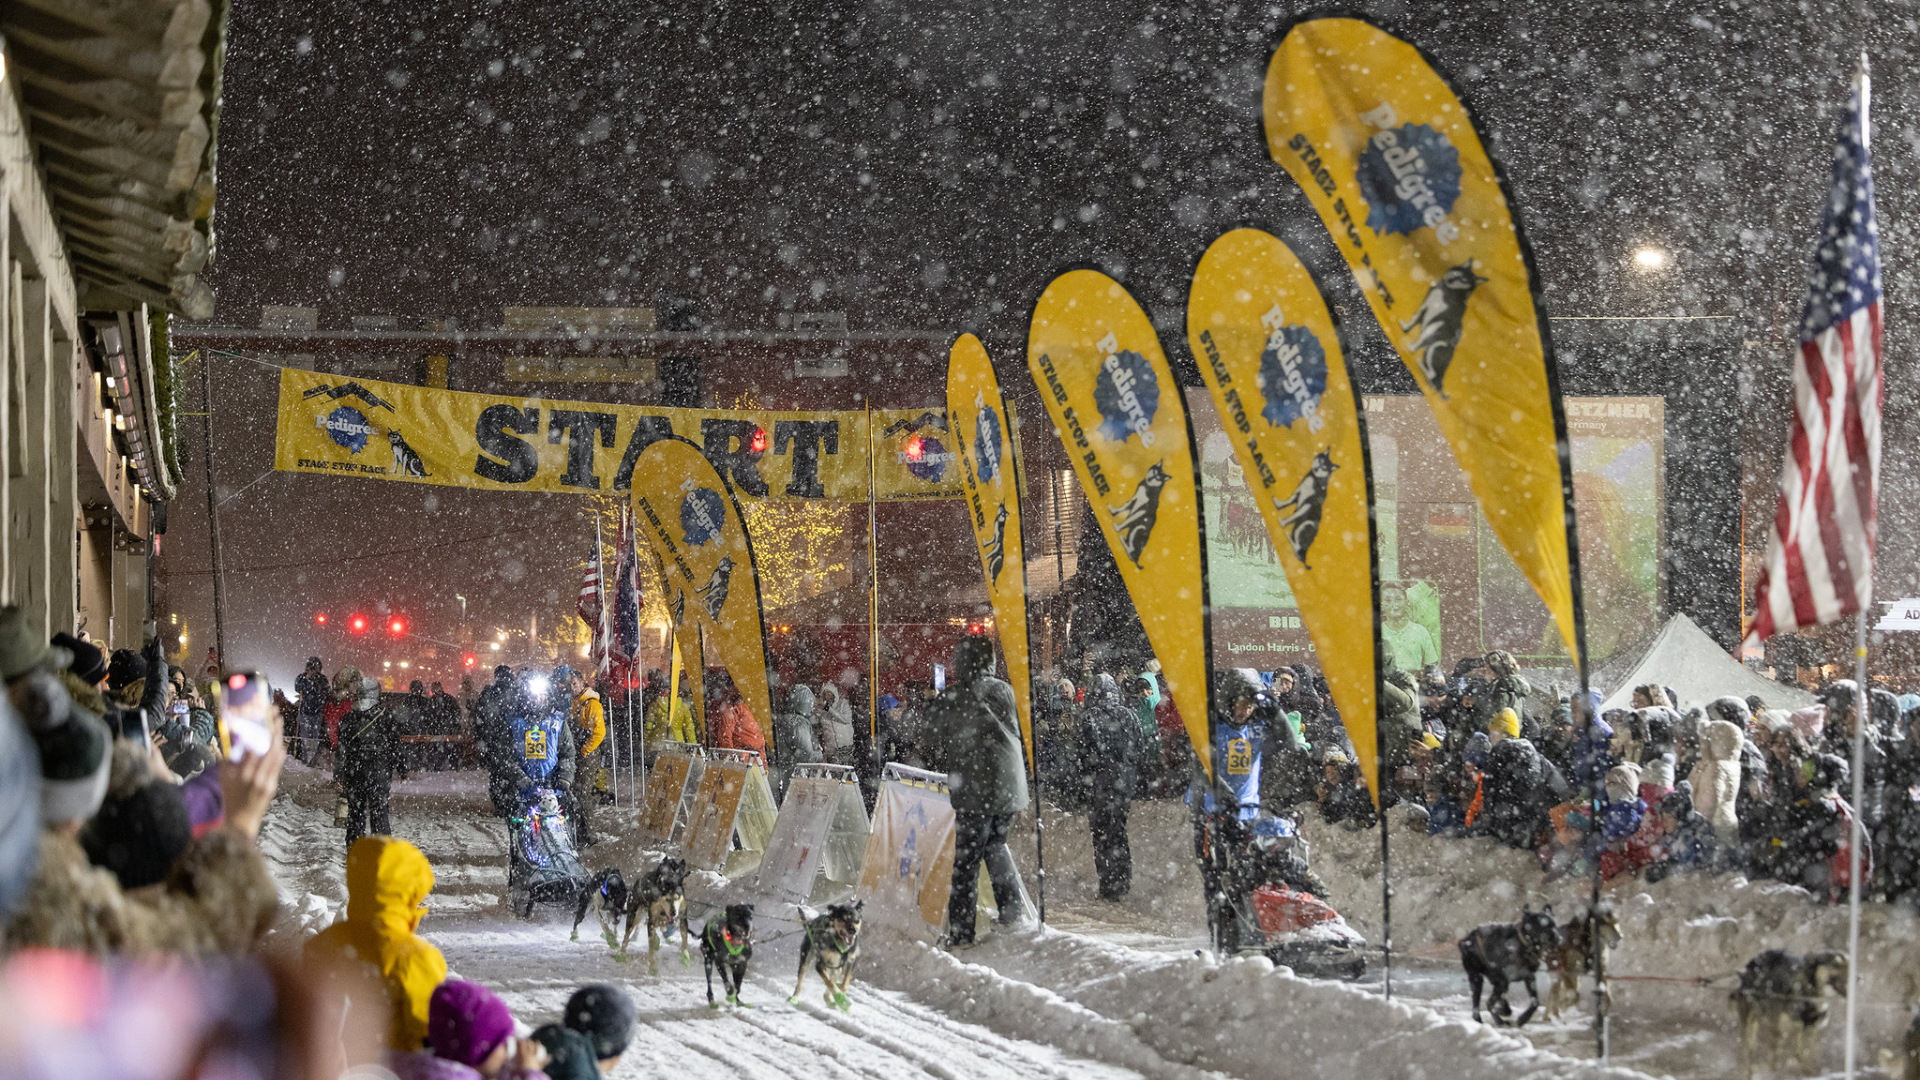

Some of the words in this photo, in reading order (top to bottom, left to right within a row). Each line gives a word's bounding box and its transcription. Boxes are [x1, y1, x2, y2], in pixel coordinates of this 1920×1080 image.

[1288, 133, 1337, 197] STAGE
[1359, 101, 1458, 246] Pedigree
[1260, 302, 1325, 435] Pedigree
[1096, 331, 1155, 449] Pedigree
[1199, 329, 1231, 388] STAGE
[1224, 388, 1250, 434] STOP
[1247, 438, 1276, 489] RACE
[315, 414, 379, 436] Pedigree
[1038, 353, 1068, 406] STAGE
[1063, 406, 1089, 450] STOP
[1083, 450, 1111, 497] RACE
[1567, 401, 1651, 419] ETZNER
[1567, 421, 1607, 431] ermany
[297, 459, 330, 469] STAGE
[332, 461, 358, 471] STOP
[360, 464, 387, 475] RACE
[679, 476, 725, 548] Pedigree
[971, 493, 987, 532] RACE
[638, 497, 662, 530] STAGE
[658, 527, 678, 554] STOP
[674, 554, 696, 583] RACE
[1269, 616, 1300, 628] BIB
[1227, 642, 1265, 652] Landon
[1267, 642, 1299, 652] Harris
[527, 743, 545, 754] 30
[1230, 755, 1250, 768] 30
